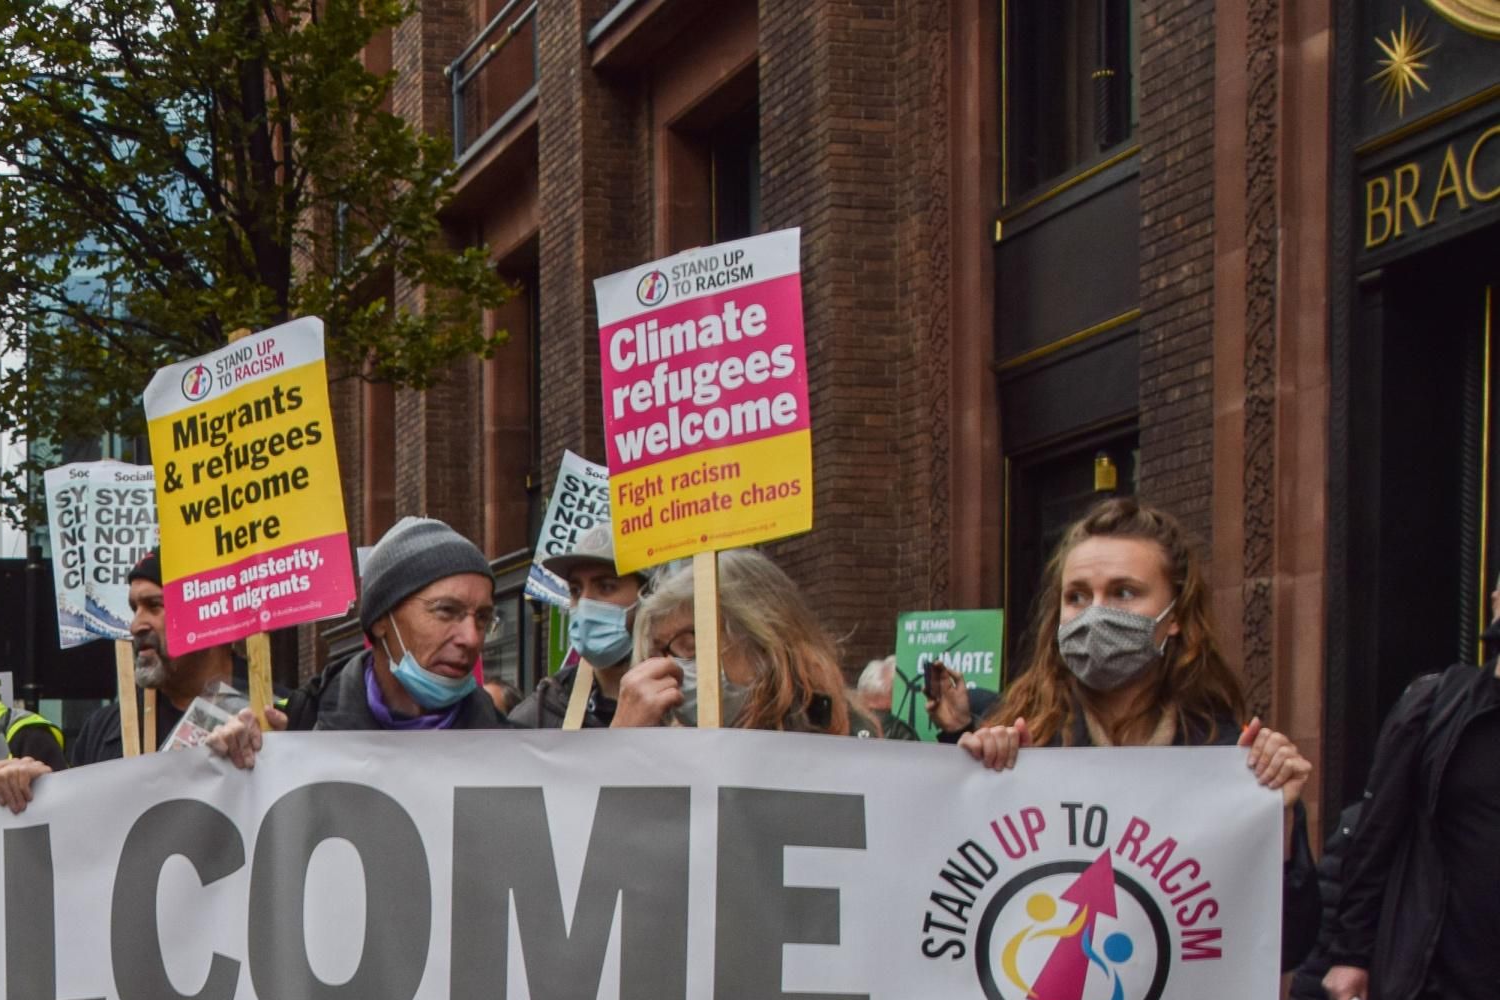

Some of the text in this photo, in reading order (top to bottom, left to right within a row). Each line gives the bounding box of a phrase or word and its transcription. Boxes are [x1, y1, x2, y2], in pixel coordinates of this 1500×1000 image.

[671, 250, 745, 282] STAND UP
[673, 264, 754, 298] TO RACISM
[215, 338, 276, 375] STAND UP
[609, 300, 767, 373] Climate
[217, 352, 285, 391] TO RACISM
[612, 344, 796, 420] refugees
[172, 384, 304, 453] Migrants
[614, 392, 798, 465] welcome
[114, 471, 154, 482] Sociali
[163, 421, 323, 494] & refugees
[94, 488, 157, 506] SYST
[180, 465, 310, 526] welcome
[618, 474, 664, 507] Fight
[671, 461, 741, 492] racism
[620, 479, 802, 536] and climate chaos
[94, 527, 150, 545] NOT
[213, 515, 281, 557] here
[182, 573, 237, 602] Blame
[198, 595, 229, 621] not
[232, 574, 311, 612] migrants
[922, 802, 1223, 963] STAND UP TO RACISM
